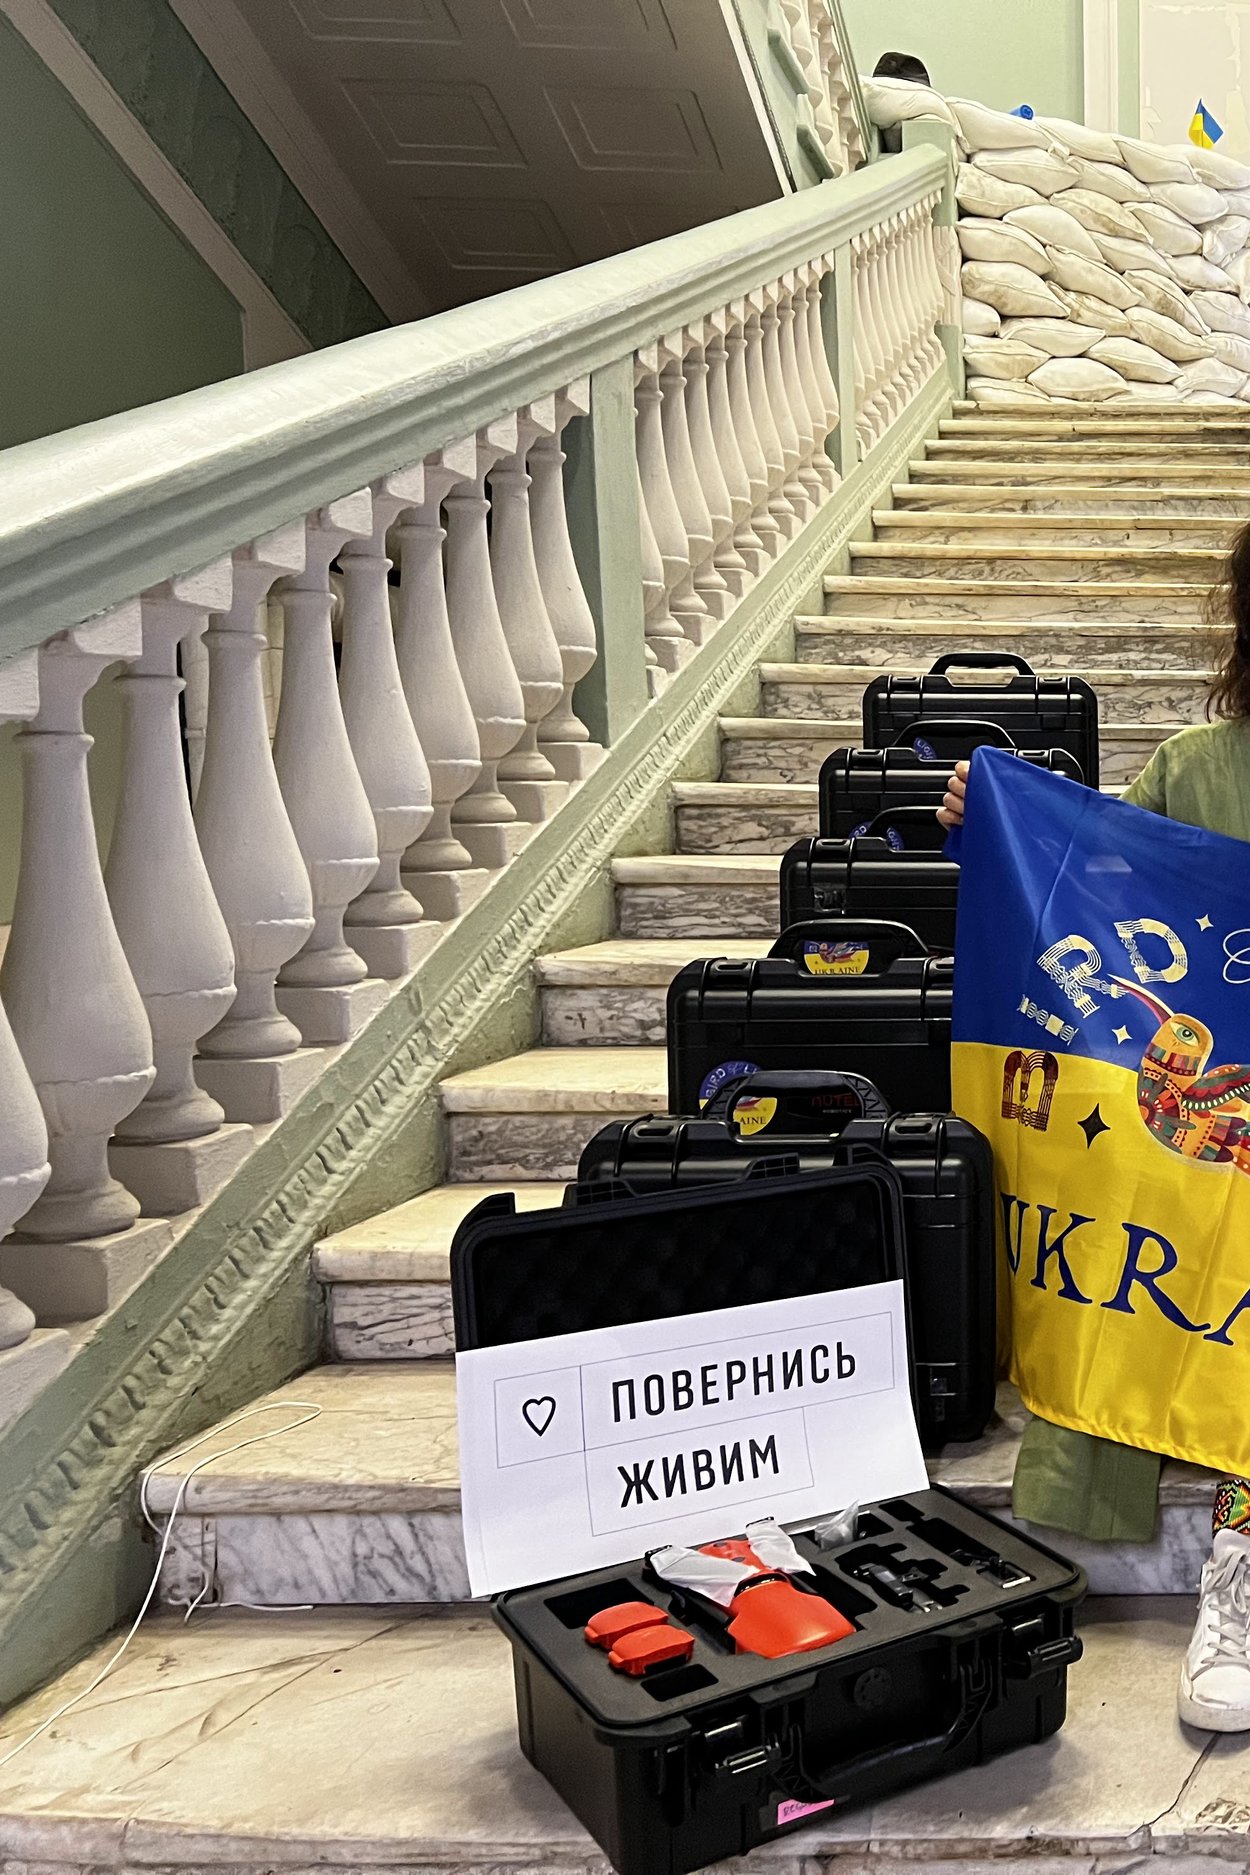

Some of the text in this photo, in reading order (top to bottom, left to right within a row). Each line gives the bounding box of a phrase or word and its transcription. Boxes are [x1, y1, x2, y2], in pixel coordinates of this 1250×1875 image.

[1000, 917, 1189, 1133] BIRD
[612, 1341, 856, 1423] ПОВЕРНИСЬ
[617, 1434, 780, 1508] ЖИВИМ
